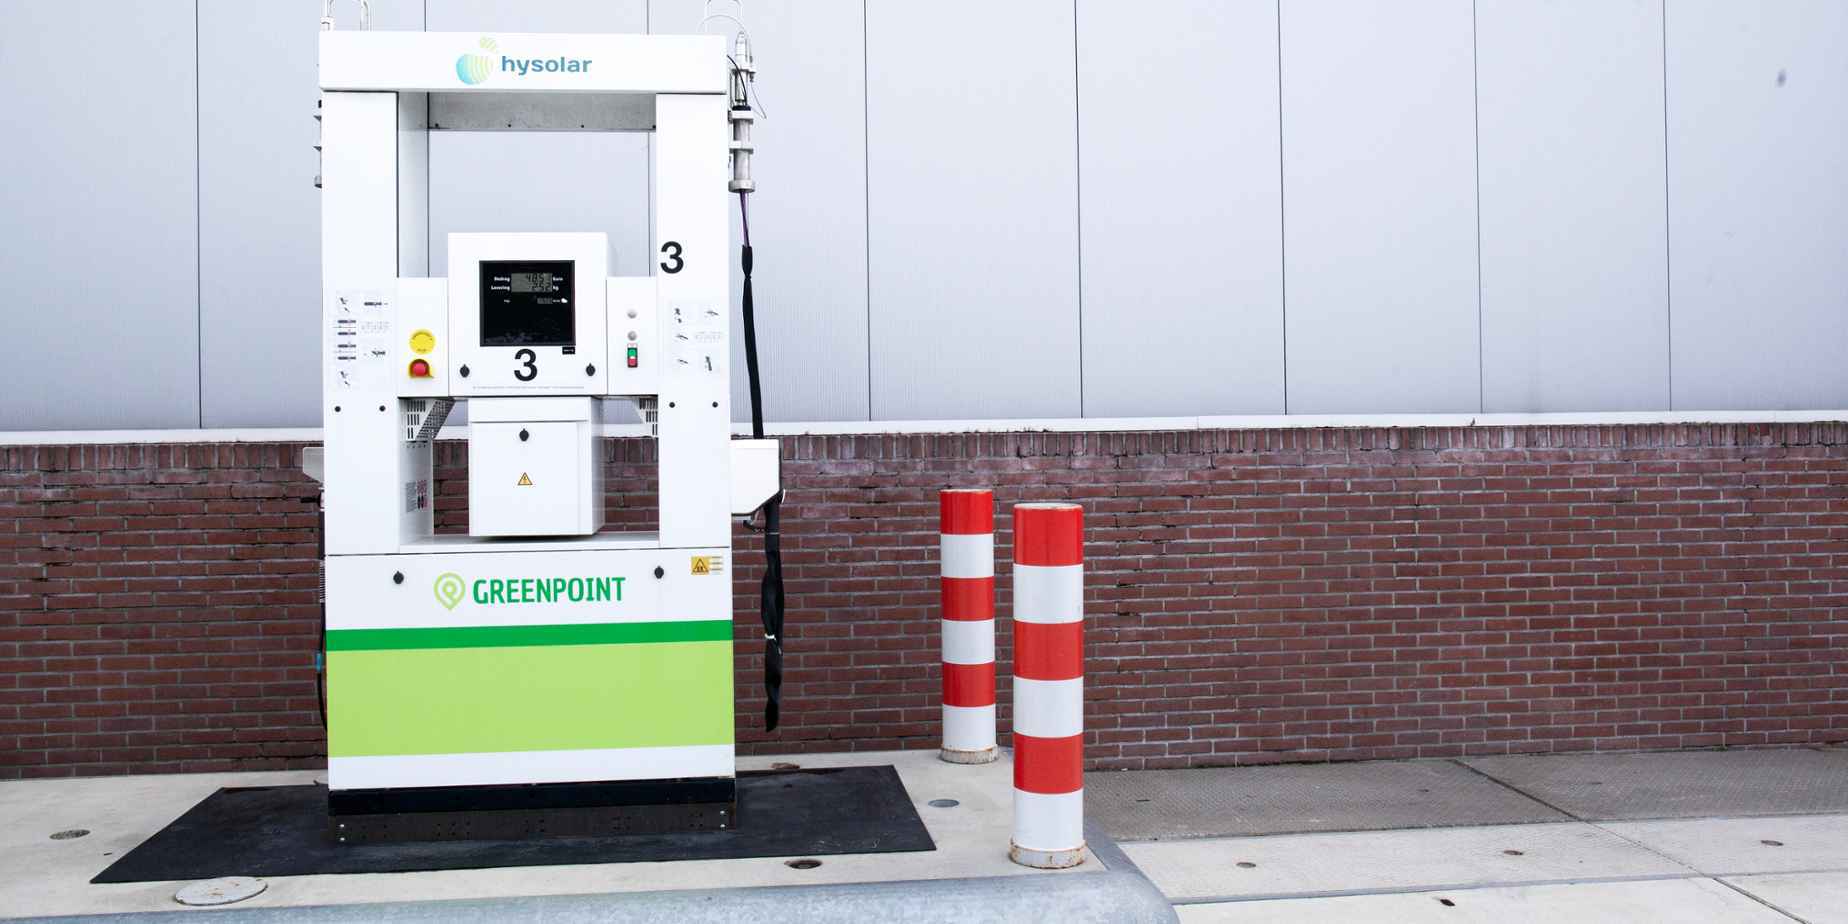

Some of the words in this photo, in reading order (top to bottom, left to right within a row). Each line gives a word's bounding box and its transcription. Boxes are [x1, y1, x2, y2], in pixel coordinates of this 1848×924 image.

[502, 55, 593, 76] hysolar
[660, 241, 684, 274] 3
[514, 348, 538, 382] 3
[472, 576, 626, 604] GREENPOINT
